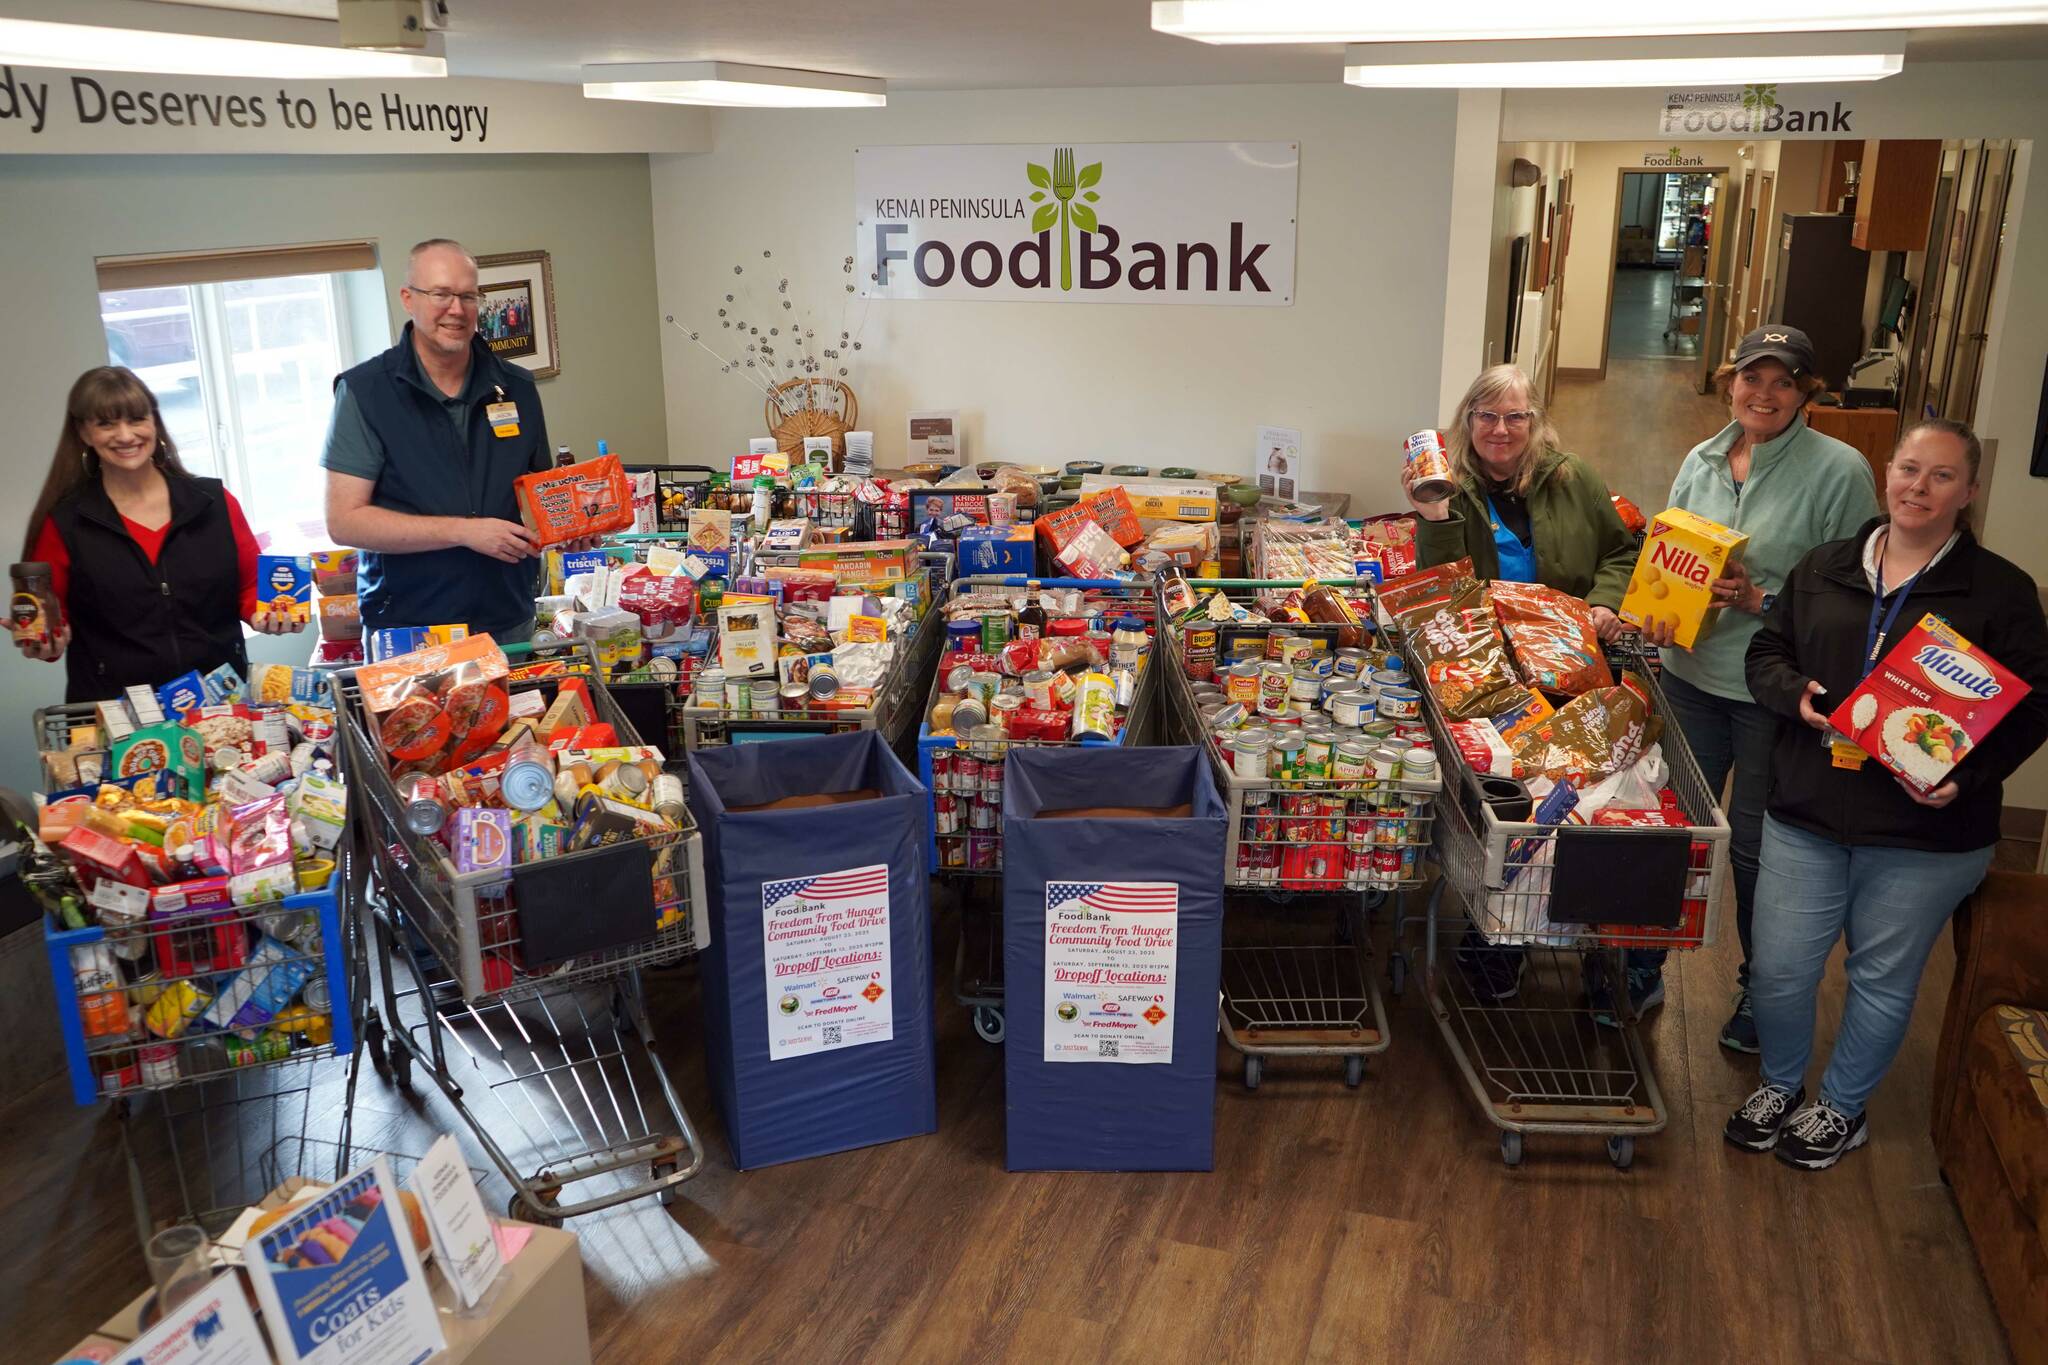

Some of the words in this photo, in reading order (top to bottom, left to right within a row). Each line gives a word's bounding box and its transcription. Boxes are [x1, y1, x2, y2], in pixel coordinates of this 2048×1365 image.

[1668, 93, 1693, 104] KENAI
[1695, 92, 1741, 103] PENINSULA
[70, 76, 267, 127] Deserves
[276, 89, 317, 130] to
[328, 87, 372, 132] be
[380, 92, 489, 143] Hungry
[1664, 104, 1750, 133] Food
[1763, 102, 1853, 133] Bank
[1643, 155, 1672, 167] Food
[1675, 155, 1704, 167] Bank
[876, 198, 926, 219] KENAI
[929, 198, 1026, 219] PENINSULA
[875, 223, 1051, 289] Food
[1079, 222, 1272, 292] Bank
[488, 336, 529, 352] OMMUNITY
[583, 504, 600, 518] 12
[877, 551, 885, 559] 12
[1712, 545, 1723, 558] 2
[567, 557, 602, 569] triscuit
[700, 557, 725, 568] trisc
[833, 562, 872, 570] MANDARIN
[1650, 540, 1711, 586] Nilla
[905, 583, 917, 592] 12
[383, 631, 392, 650] pack
[1193, 634, 1216, 643] BUSH'S
[1869, 632, 1886, 660] Walmart
[1913, 646, 2001, 698] Minute
[1884, 671, 1912, 692] WHITE
[1910, 685, 1932, 703] RICE
[1967, 711, 1975, 720] 5
[775, 906, 800, 917] Food
[802, 903, 826, 913] Bank
[1058, 912, 1084, 920] Food
[1086, 912, 1111, 921] Bank
[768, 915, 813, 931] Freedom
[815, 911, 843, 924] From
[845, 906, 886, 918] Hunger
[767, 925, 828, 942] Community
[830, 920, 856, 932] Food
[858, 916, 887, 928] Drive
[1050, 923, 1097, 934] Freedom
[1099, 924, 1128, 935] From
[1131, 925, 1173, 938] Hunger
[786, 938, 818, 946] SATURDAY,
[819, 934, 842, 942] AUGUST
[1049, 934, 1111, 948] Community
[1114, 936, 1141, 947] Food
[1143, 937, 1174, 947] Drive
[772, 953, 802, 961] SATURDAY,
[806, 948, 837, 957] SEPTEMBER
[775, 957, 820, 976] Dropoff
[822, 951, 882, 970] Locations:
[784, 981, 817, 992] Walmart
[837, 974, 870, 984] SAFEWAY
[1054, 968, 1101, 984] Dropoff
[1104, 969, 1167, 984] Locations:
[1062, 992, 1096, 1001] Walmart
[1118, 994, 1153, 1002] SAFEWAY
[823, 1019, 844, 1027] DONATE
[308, 1286, 381, 1344] Coats
[336, 1326, 364, 1354] for
[366, 1294, 405, 1332] Kids
